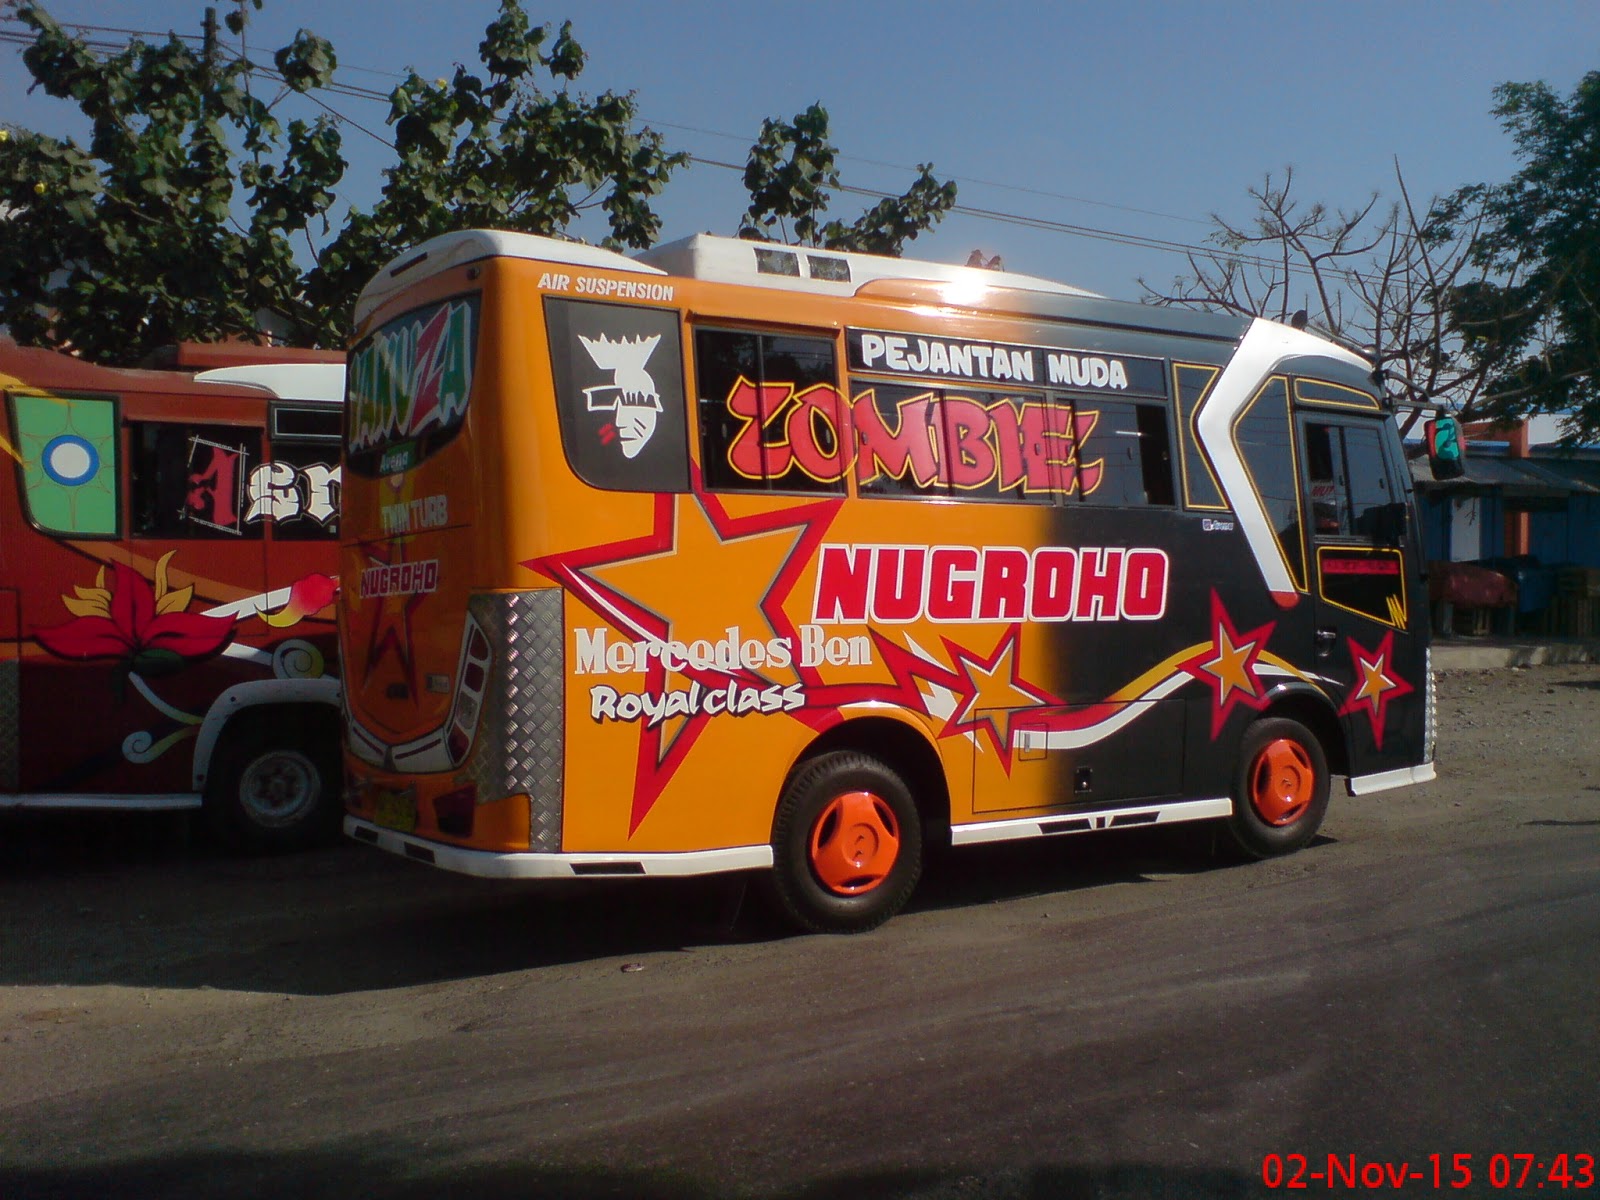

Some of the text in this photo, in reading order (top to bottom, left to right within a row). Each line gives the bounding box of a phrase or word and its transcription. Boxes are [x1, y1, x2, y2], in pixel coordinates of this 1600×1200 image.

[537, 272, 674, 301] AIR SUSPENSION
[860, 334, 1128, 390] PEJANTAN MUDA
[727, 375, 1104, 495] ZOMBIE
[360, 558, 439, 599] NUGROHO
[810, 543, 1169, 624] NUGROHO
[573, 624, 872, 674] Mercedes Ben
